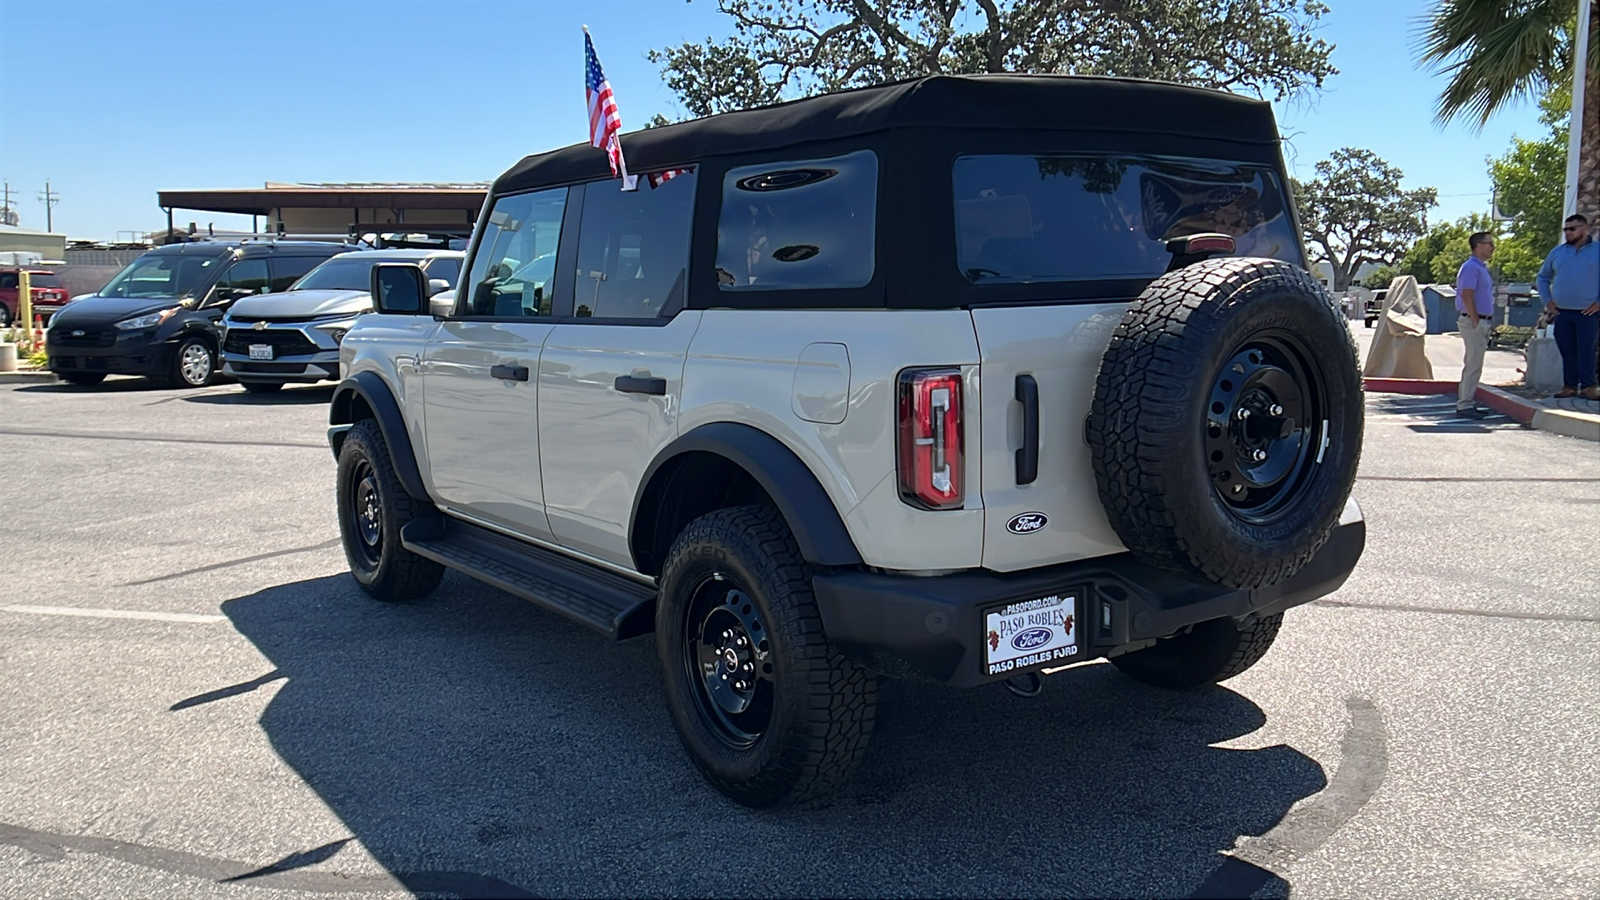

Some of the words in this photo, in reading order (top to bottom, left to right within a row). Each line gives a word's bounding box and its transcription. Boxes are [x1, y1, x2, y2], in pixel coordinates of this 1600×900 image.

[1015, 515, 1042, 530] Ford
[1000, 616, 1025, 638] PASO
[1028, 609, 1064, 626] ROBLES
[1019, 630, 1045, 647] Ford
[989, 661, 1014, 675] PASO
[1016, 652, 1052, 667] ROBLES
